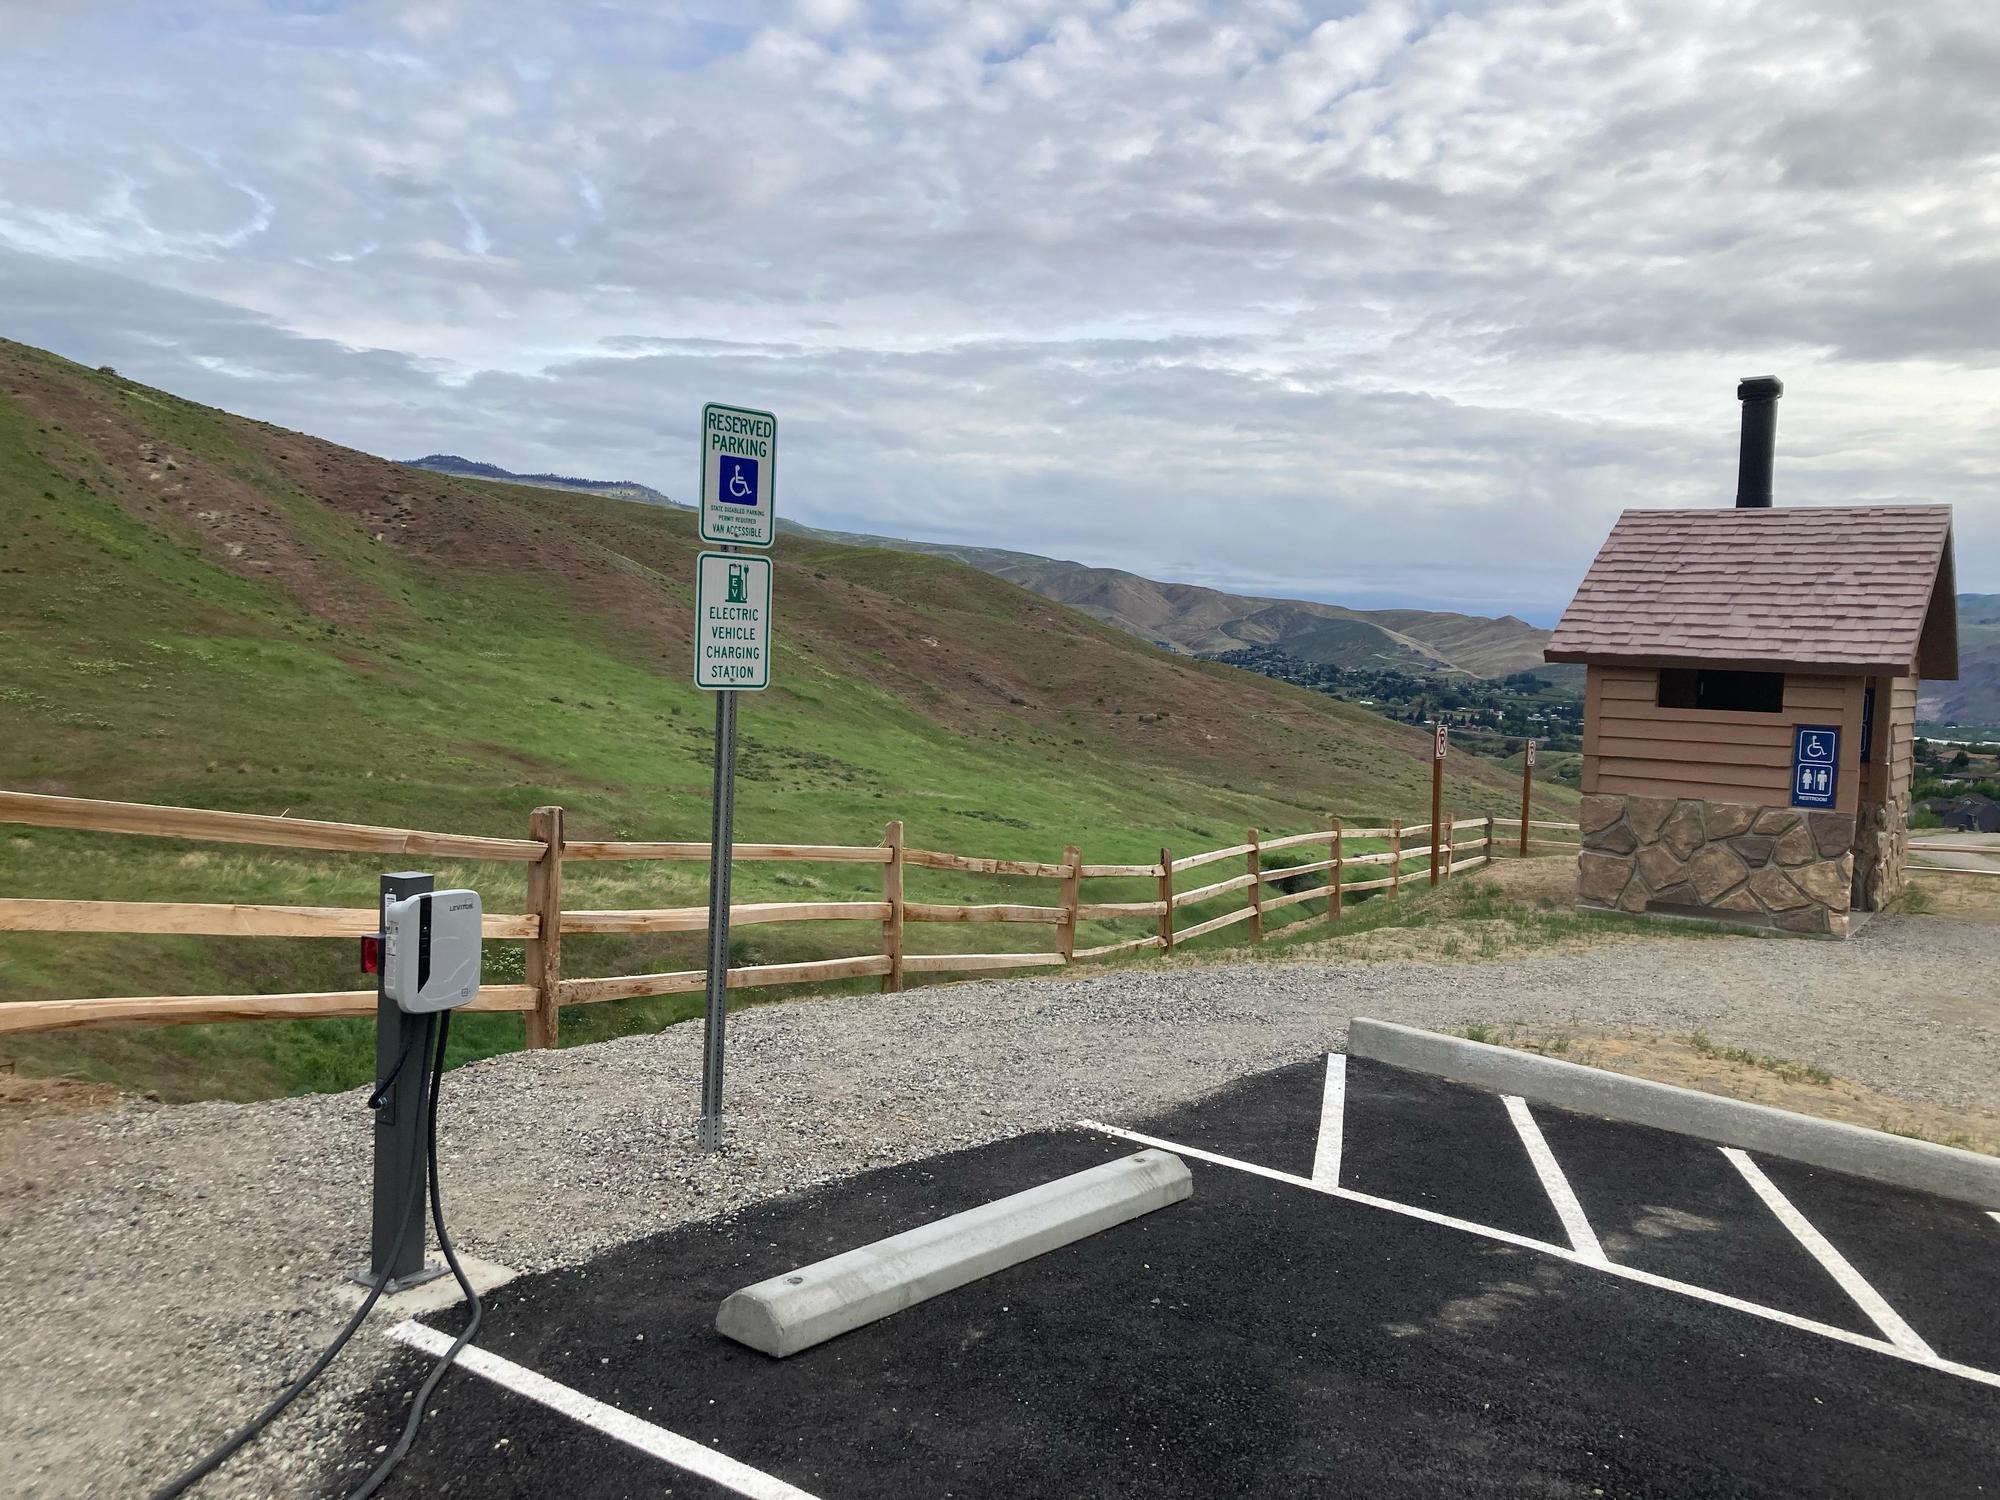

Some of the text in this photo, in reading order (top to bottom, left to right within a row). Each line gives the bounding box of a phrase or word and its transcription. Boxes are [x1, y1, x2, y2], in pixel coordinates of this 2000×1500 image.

[709, 413, 772, 438] RESERVED
[712, 434, 767, 457] PARKING
[725, 507, 745, 515] DISABLED
[747, 508, 765, 517] PARKING
[713, 524, 762, 538] VAN ACCESSIBLE
[709, 606, 759, 622] ELECTRIC
[712, 626, 756, 641] VEHICLE
[706, 645, 760, 660] CHARGING
[711, 665, 754, 679] STATION
[449, 902, 474, 912] LEVITON
